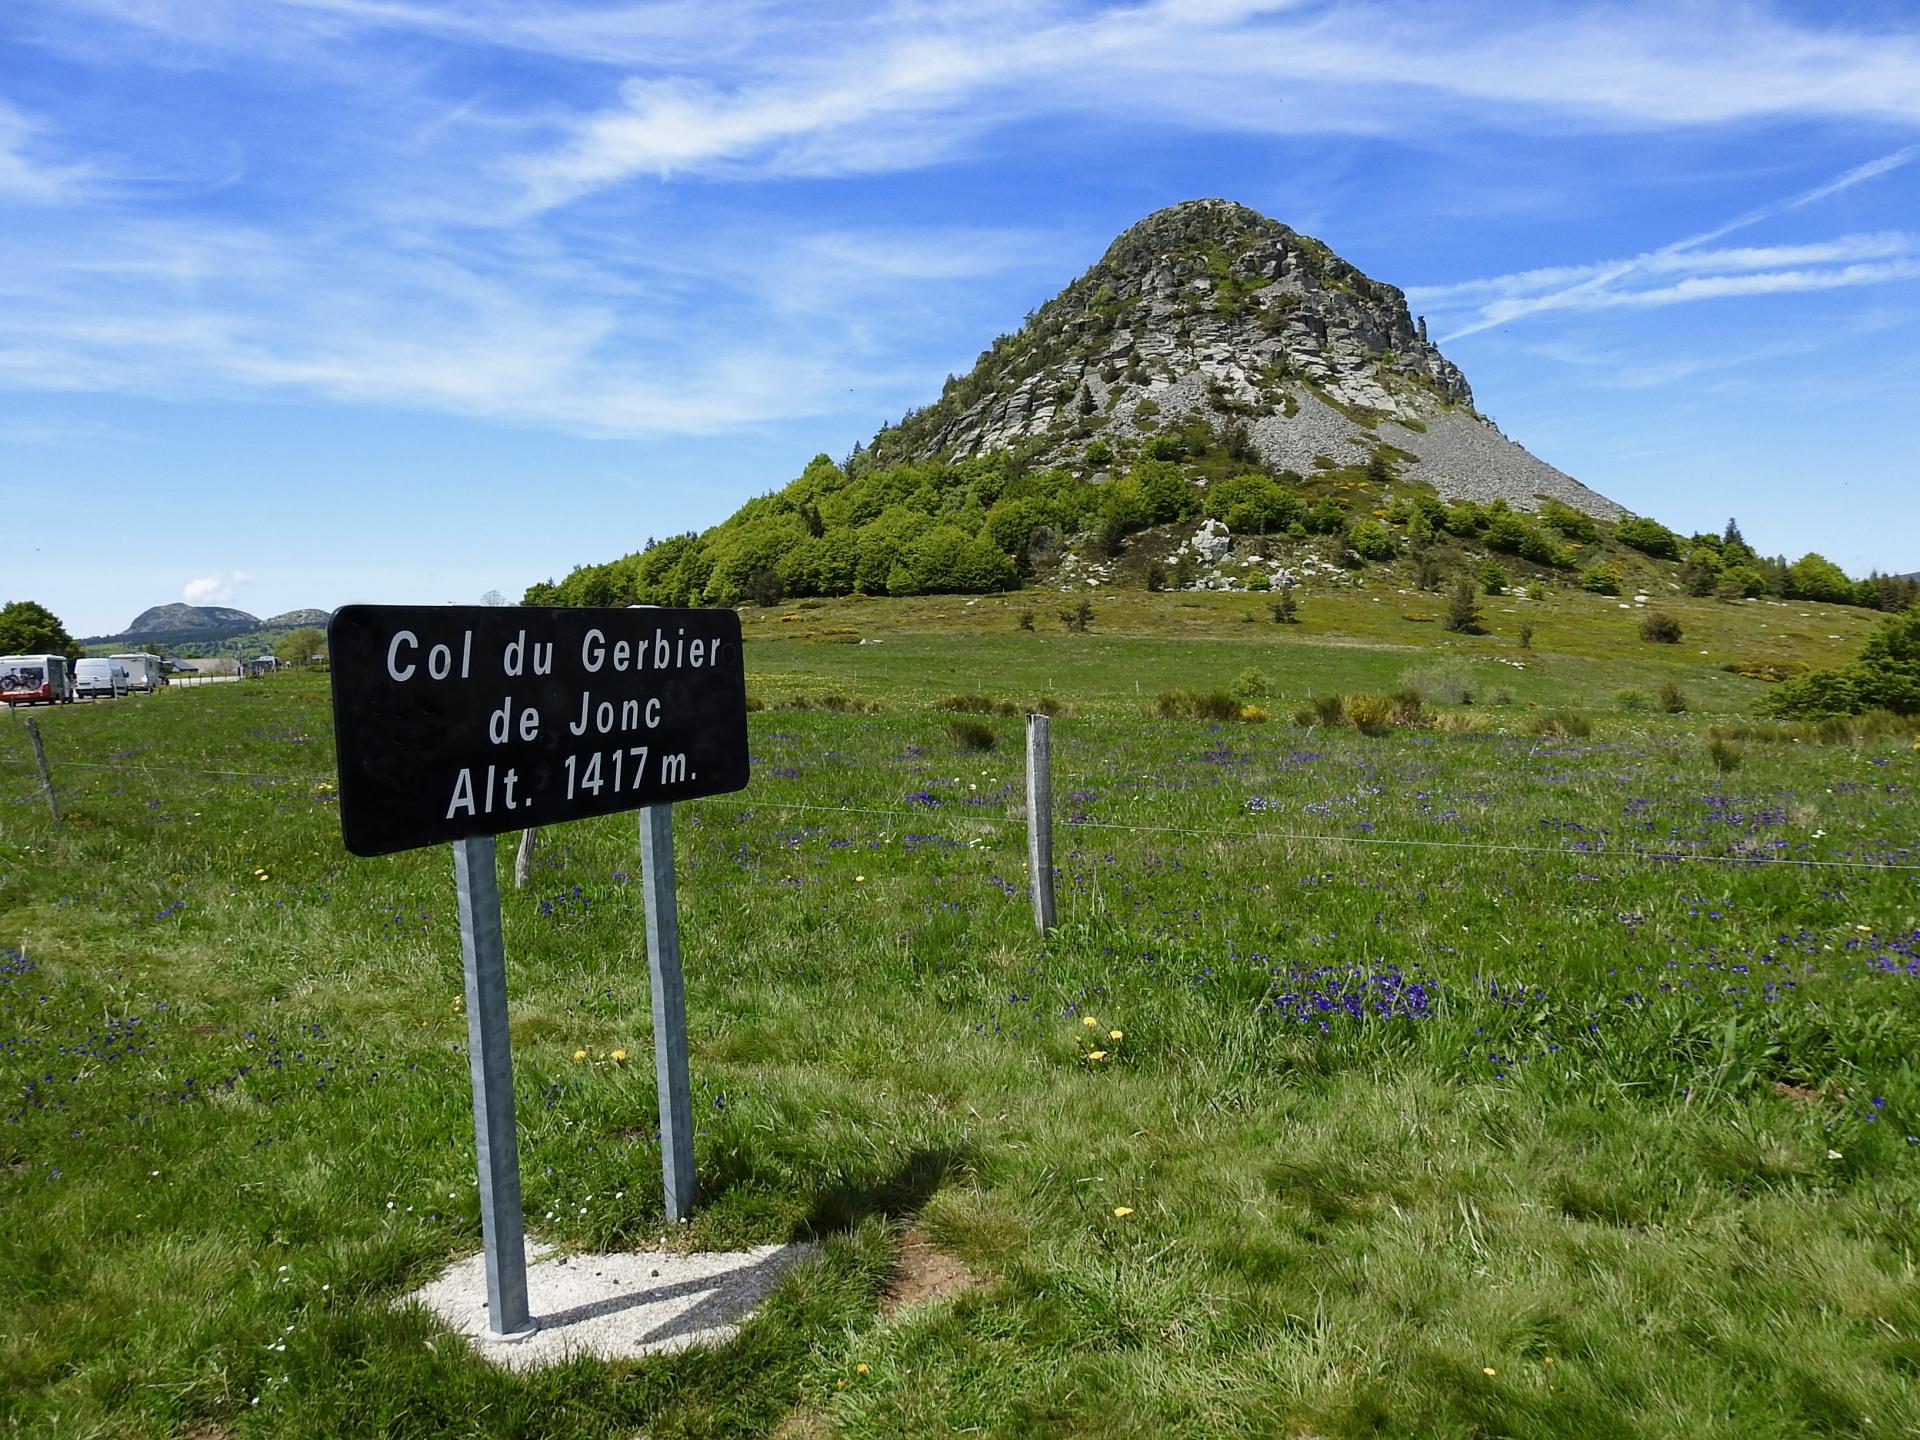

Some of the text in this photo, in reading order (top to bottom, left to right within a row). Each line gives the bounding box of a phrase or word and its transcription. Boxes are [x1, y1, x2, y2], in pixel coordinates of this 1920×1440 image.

[387, 628, 720, 682] Col du Gerbier
[489, 691, 661, 745] de Jonc
[445, 746, 697, 820] Alt. 1417 m.
